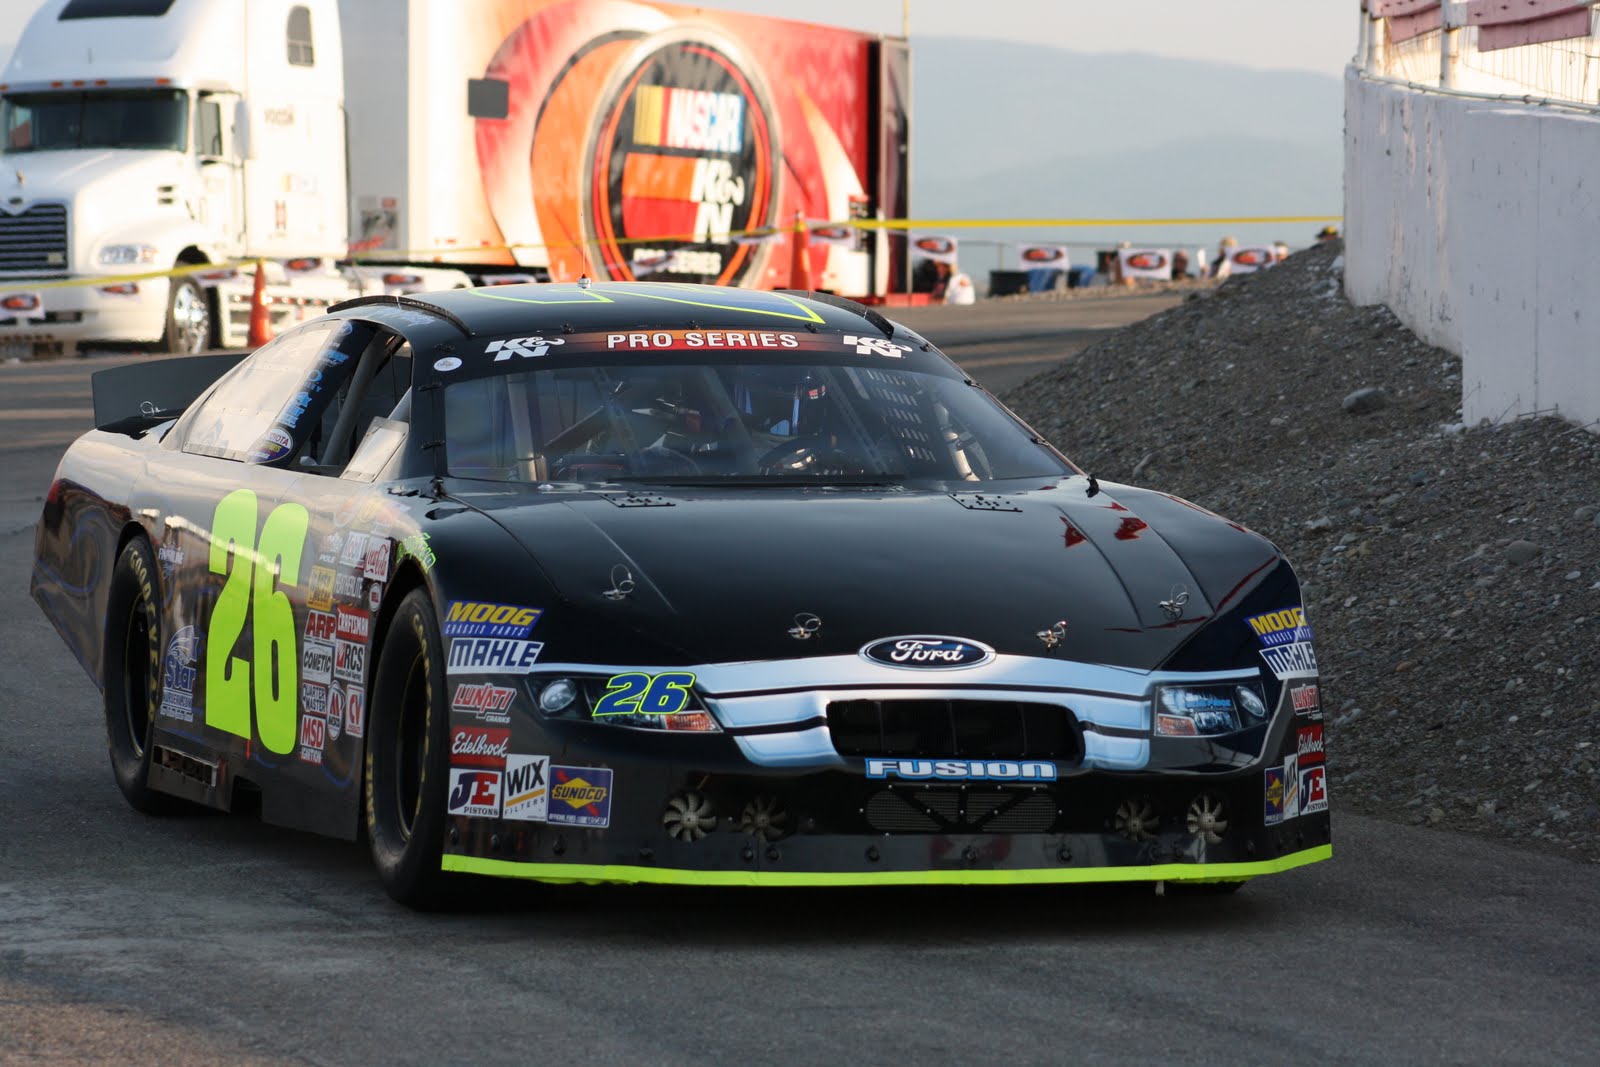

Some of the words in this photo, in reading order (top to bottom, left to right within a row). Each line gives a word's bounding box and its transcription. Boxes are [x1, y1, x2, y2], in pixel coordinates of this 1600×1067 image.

[606, 333, 673, 349] PRO
[685, 333, 799, 348] SERIES
[205, 488, 309, 755] 26
[305, 611, 337, 640] ARP
[446, 602, 542, 626] MOOG
[1248, 606, 1308, 636] MOOG
[445, 624, 486, 635] CHASSIS
[490, 625, 525, 637] PARTS
[303, 650, 332, 673] COMETIC
[343, 642, 364, 672] RCS
[449, 639, 541, 668] MAHLE
[890, 639, 965, 661] Ford
[1261, 643, 1317, 674] MAHLE
[302, 682, 326, 701] QUARTER
[302, 695, 327, 713] MASTER
[453, 684, 514, 712] LUNATI
[592, 671, 697, 716] 26
[302, 717, 324, 748] MSD
[486, 715, 511, 723] CRANKS
[452, 731, 509, 758] Edelbrock
[450, 771, 499, 811] JE
[506, 759, 545, 797] WIX
[1300, 767, 1324, 812] JE
[504, 797, 545, 816] FILTERS
[553, 785, 606, 801] SUNOCO
[463, 806, 499, 816] PISTONS
[1307, 801, 1328, 813] PISTONS
